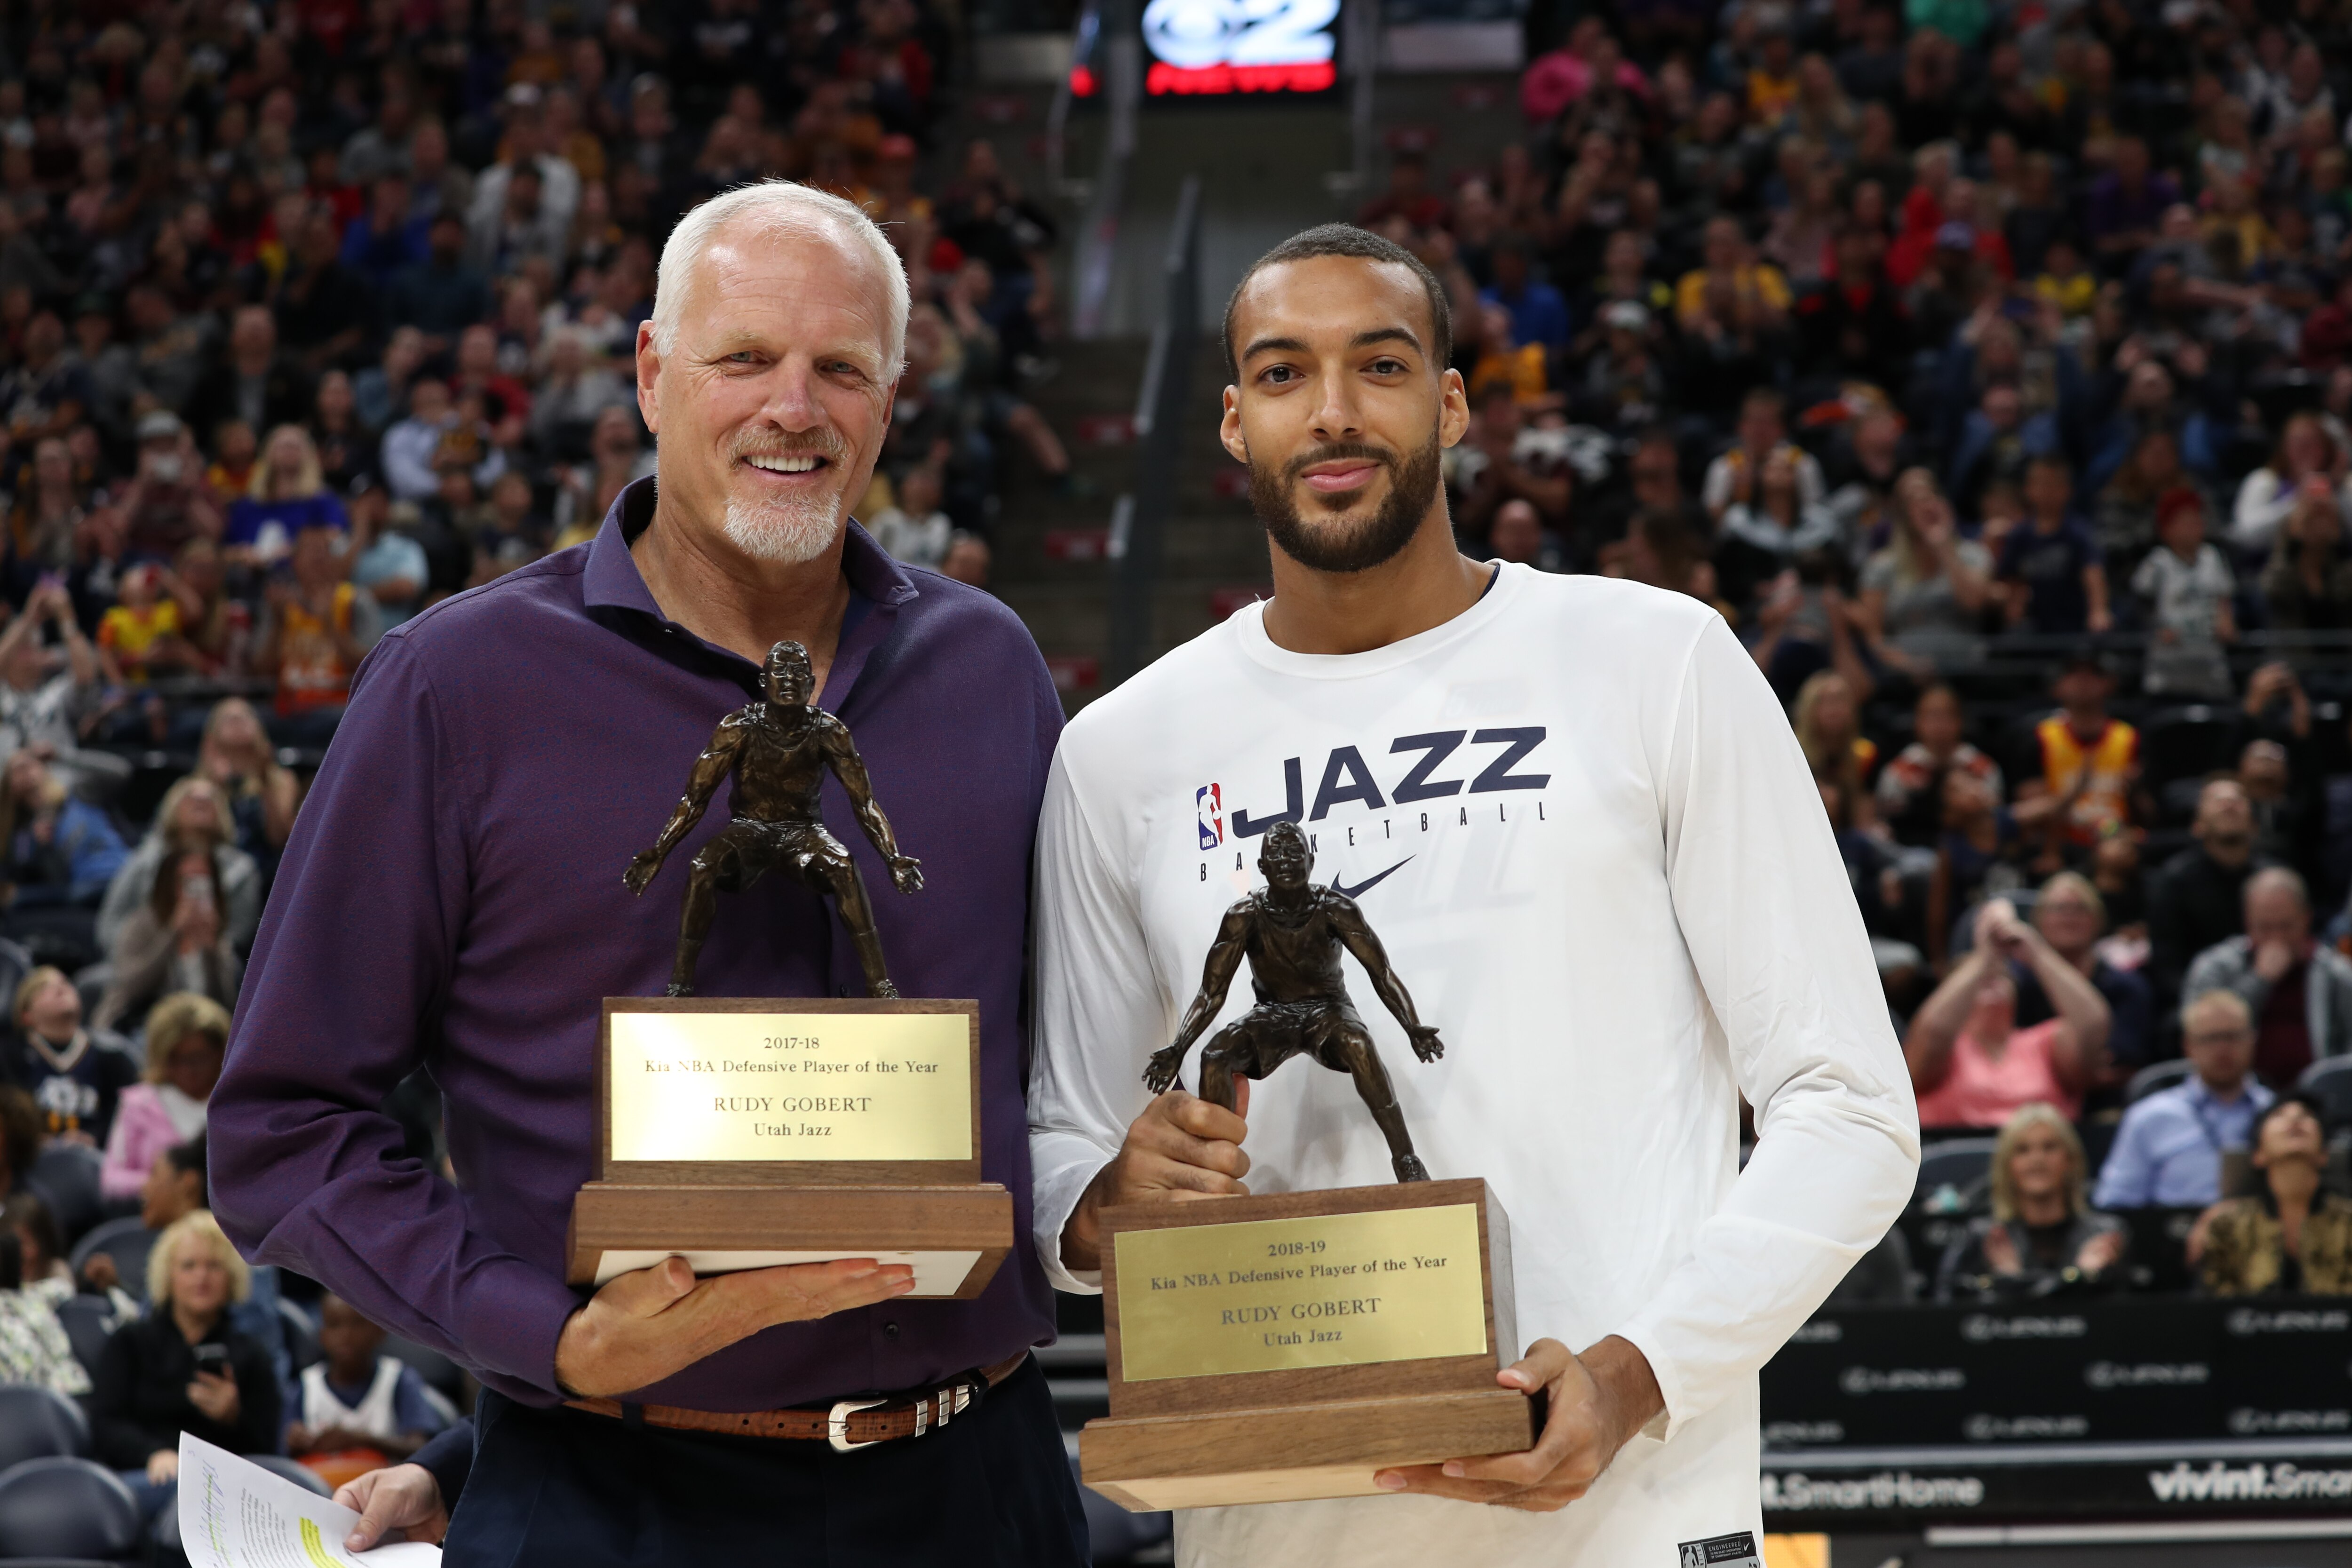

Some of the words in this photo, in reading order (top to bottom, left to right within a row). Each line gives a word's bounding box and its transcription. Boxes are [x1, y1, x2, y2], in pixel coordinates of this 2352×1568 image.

[1231, 727, 1551, 839] JAZZ
[1200, 801, 1545, 882] BAKETBALL
[1202, 835, 1215, 848] NBA
[763, 1037, 820, 1049] 2017-18
[645, 1060, 670, 1073] Kia
[678, 1060, 715, 1072] NBA
[723, 1060, 797, 1073] Defensive
[803, 1060, 850, 1075] Player
[855, 1060, 870, 1073] of
[876, 1060, 899, 1073] the
[904, 1060, 939, 1073] Year
[714, 1097, 774, 1112] RUDY
[782, 1097, 873, 1113] GOBERT
[754, 1123, 792, 1136] Utah
[798, 1123, 832, 1136] Jazz
[1268, 1240, 1326, 1257] 2018-19
[1152, 1278, 1176, 1290] Kia
[1184, 1273, 1221, 1287] NBA
[1229, 1269, 1303, 1284] Defensive
[1311, 1264, 1357, 1278] Player
[1363, 1259, 1377, 1273] of
[1383, 1259, 1406, 1271] the
[1413, 1256, 1447, 1269] Year
[1222, 1305, 1281, 1325] RUDY
[1291, 1297, 1382, 1319] GOBERT
[1264, 1331, 1302, 1347] Utah
[1309, 1329, 1342, 1343] Jazz
[1708, 1541, 1740, 1552] ENGINEERED
